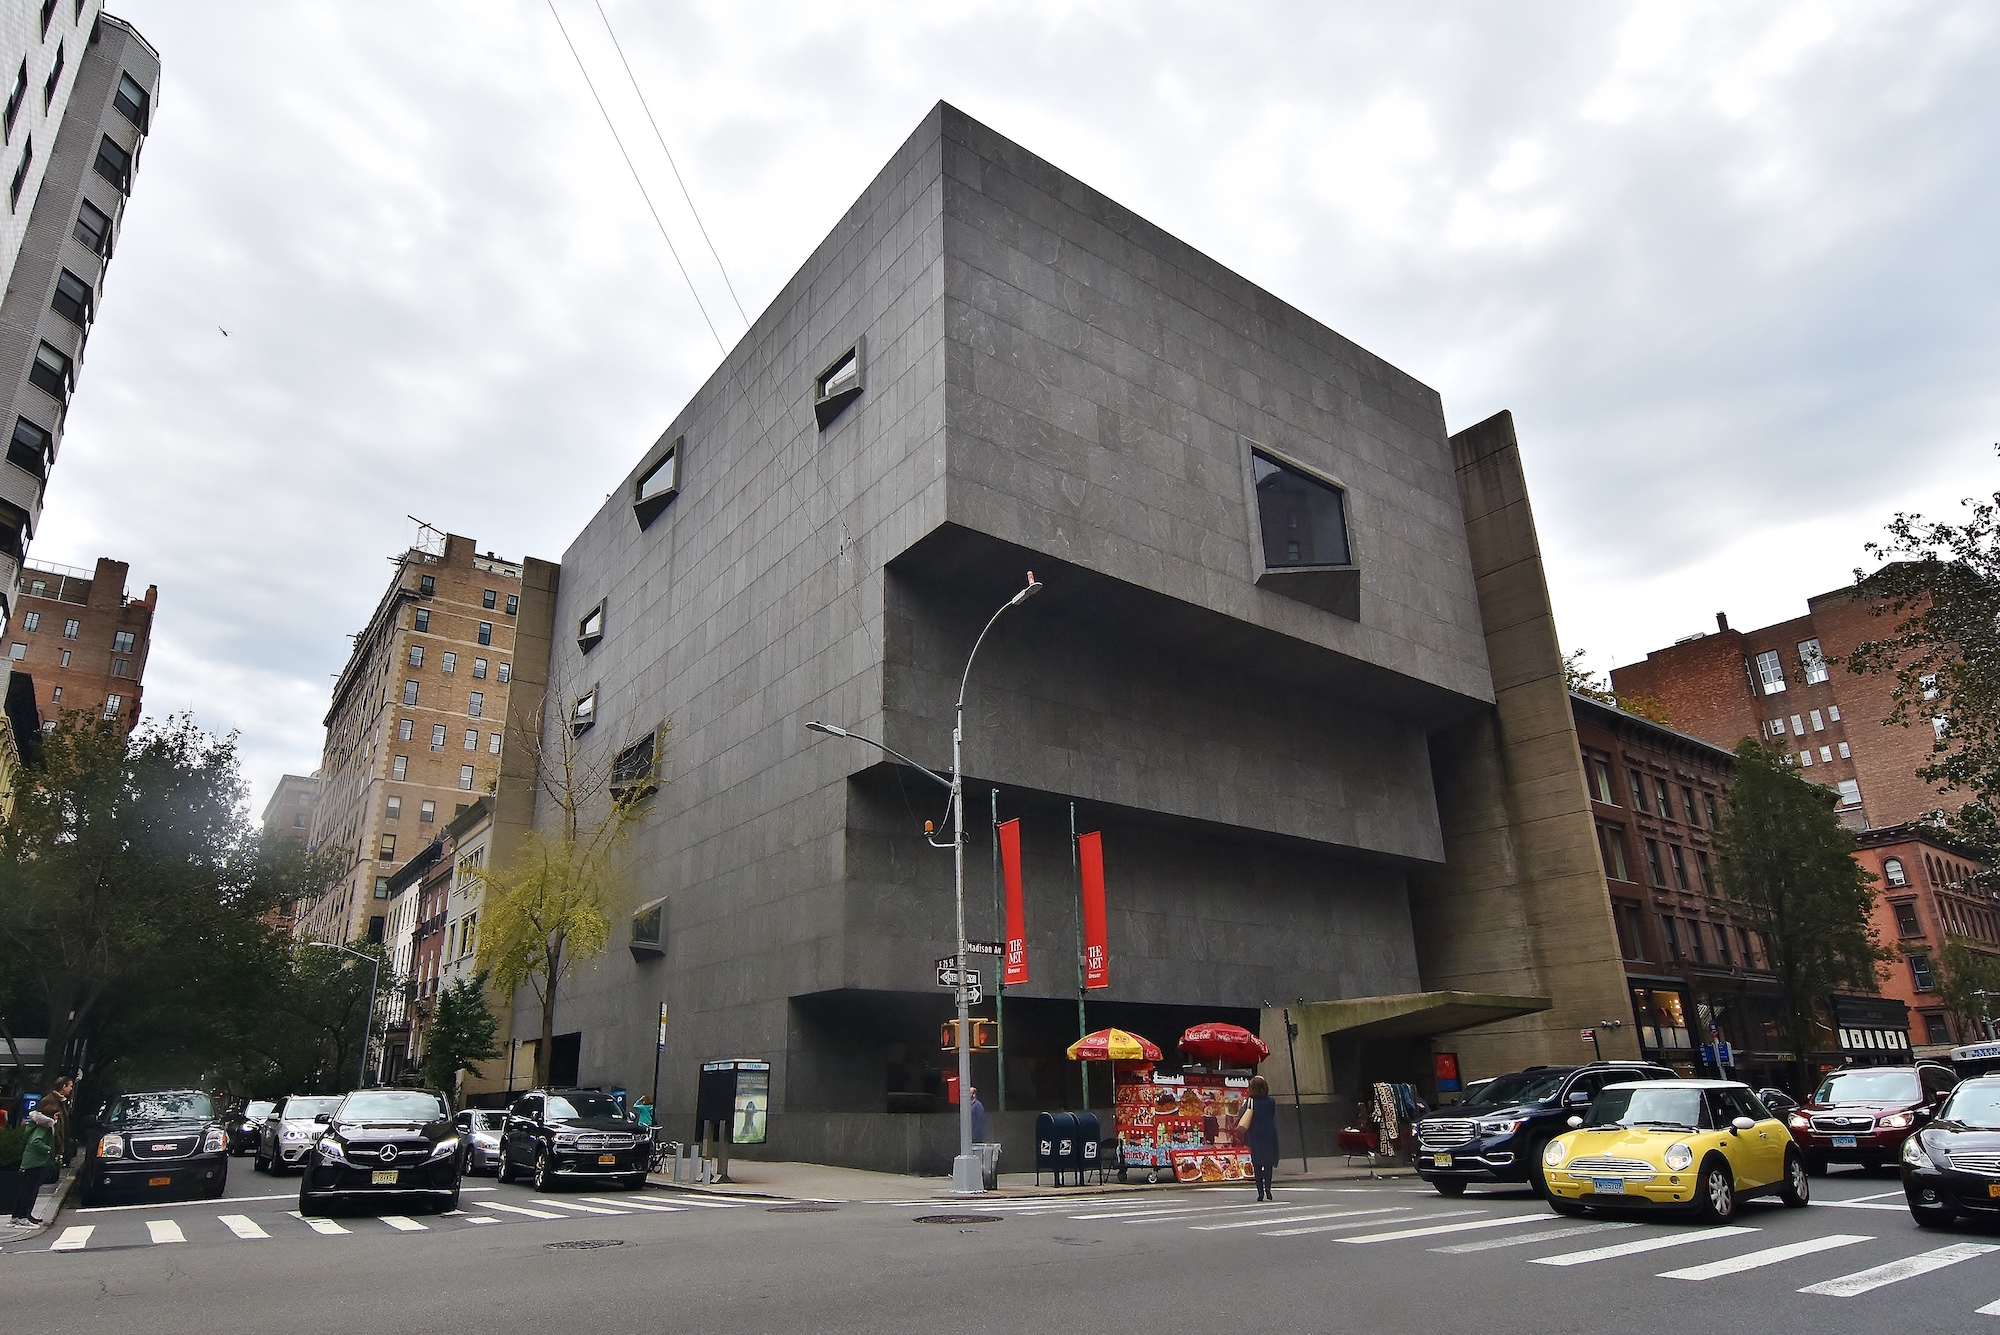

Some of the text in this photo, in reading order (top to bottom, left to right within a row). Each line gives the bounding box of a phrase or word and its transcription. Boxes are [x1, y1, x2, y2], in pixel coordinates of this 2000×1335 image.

[967, 944, 1002, 955] Madison Av
[1009, 939, 1023, 952] THE
[1088, 945, 1103, 958] THE
[949, 958, 955, 967] St
[1008, 951, 1023, 965] MET
[1088, 957, 1103, 970] MET
[28, 1100, 36, 1110] P
[151, 1143, 178, 1151] GMC
